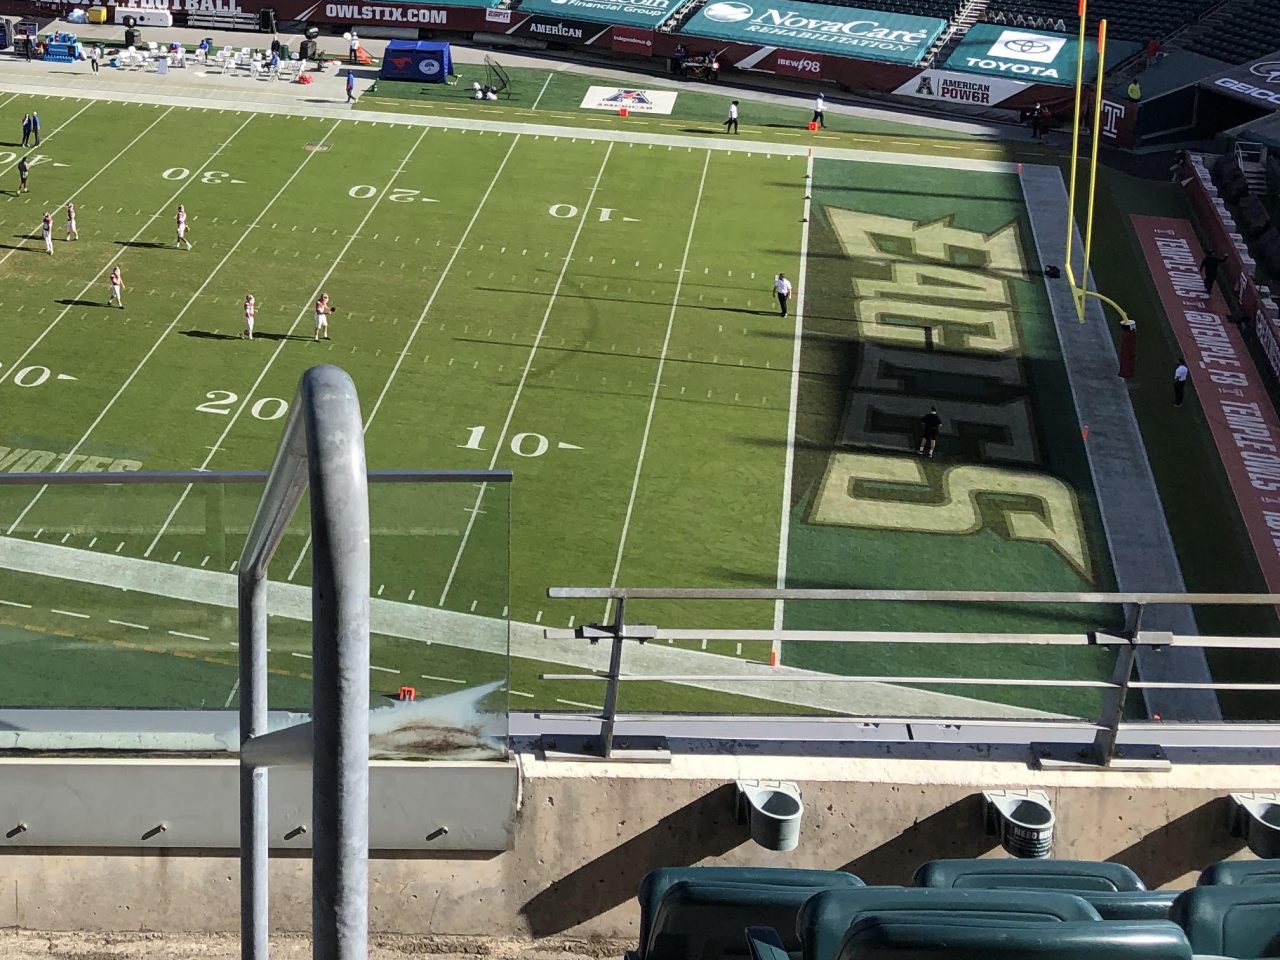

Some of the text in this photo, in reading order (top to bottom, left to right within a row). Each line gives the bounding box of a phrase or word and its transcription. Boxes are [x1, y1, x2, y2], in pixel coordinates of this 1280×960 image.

[325, 3, 447, 24] OWLSTIX.COM
[567, 0, 621, 11] Financial
[530, 22, 583, 38] AMERICAN
[745, 25, 912, 52] REHABILITATION
[756, 9, 923, 43] NovaCare
[777, 57, 821, 73] IBEW/98
[966, 57, 1059, 79] TOYOTA
[942, 79, 990, 93] AMERICAN
[1154, 237, 1200, 272] TEMPLE
[1168, 271, 1211, 299] OWLS
[195, 390, 289, 420] 20
[808, 205, 1095, 585] EAGLES
[1220, 400, 1277, 452] TEMPLE
[456, 425, 550, 457] 10
